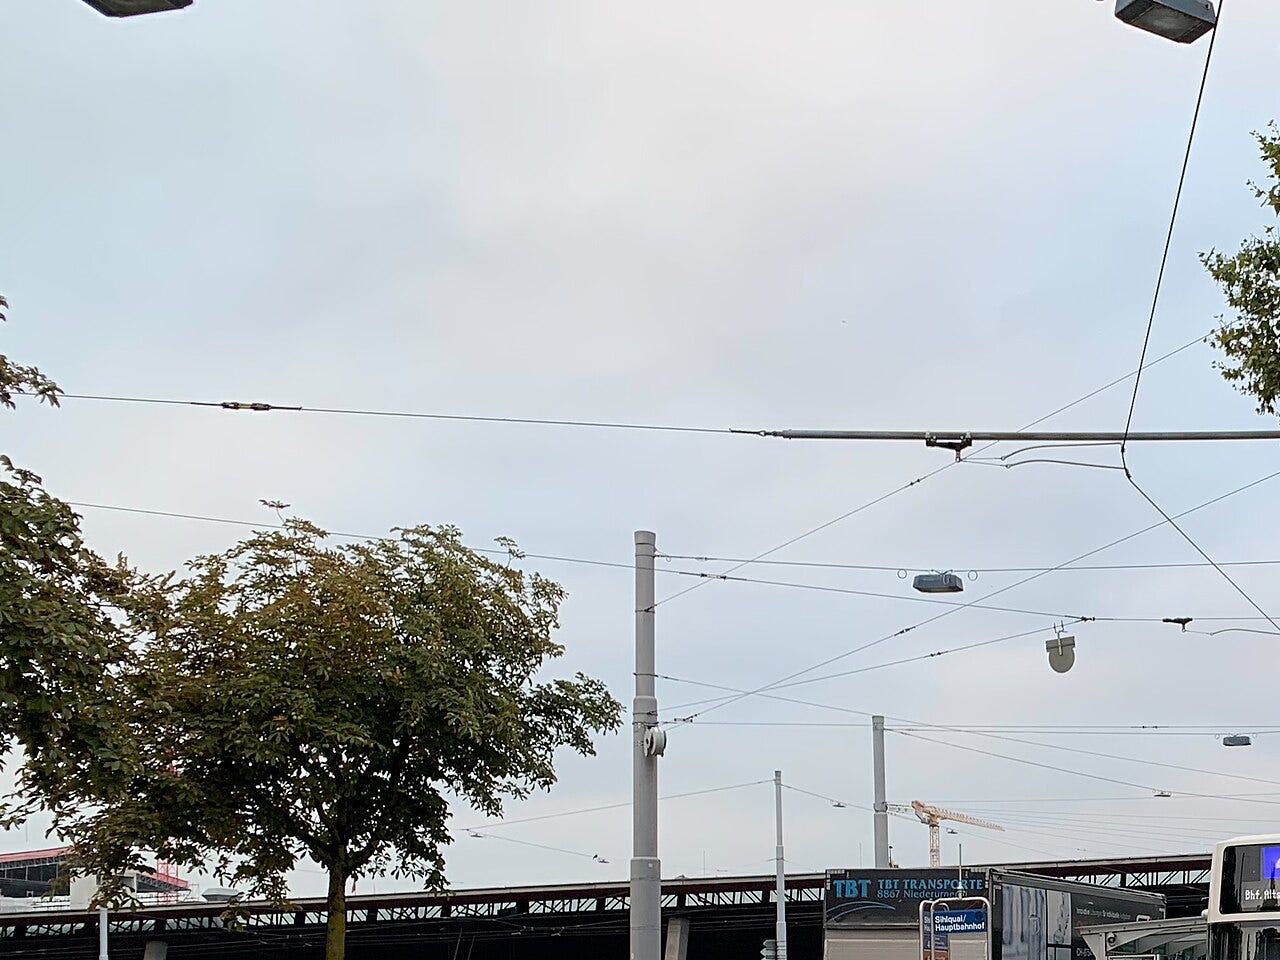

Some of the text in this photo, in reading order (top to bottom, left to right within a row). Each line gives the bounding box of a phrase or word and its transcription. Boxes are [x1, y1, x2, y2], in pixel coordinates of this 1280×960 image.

[833, 879, 871, 898] TBT
[878, 879, 983, 889] TBT TRANSPORTE
[877, 889, 900, 899] 8867
[1245, 889, 1262, 900] Bhf.
[935, 922, 985, 932] Hauptbahnhof
